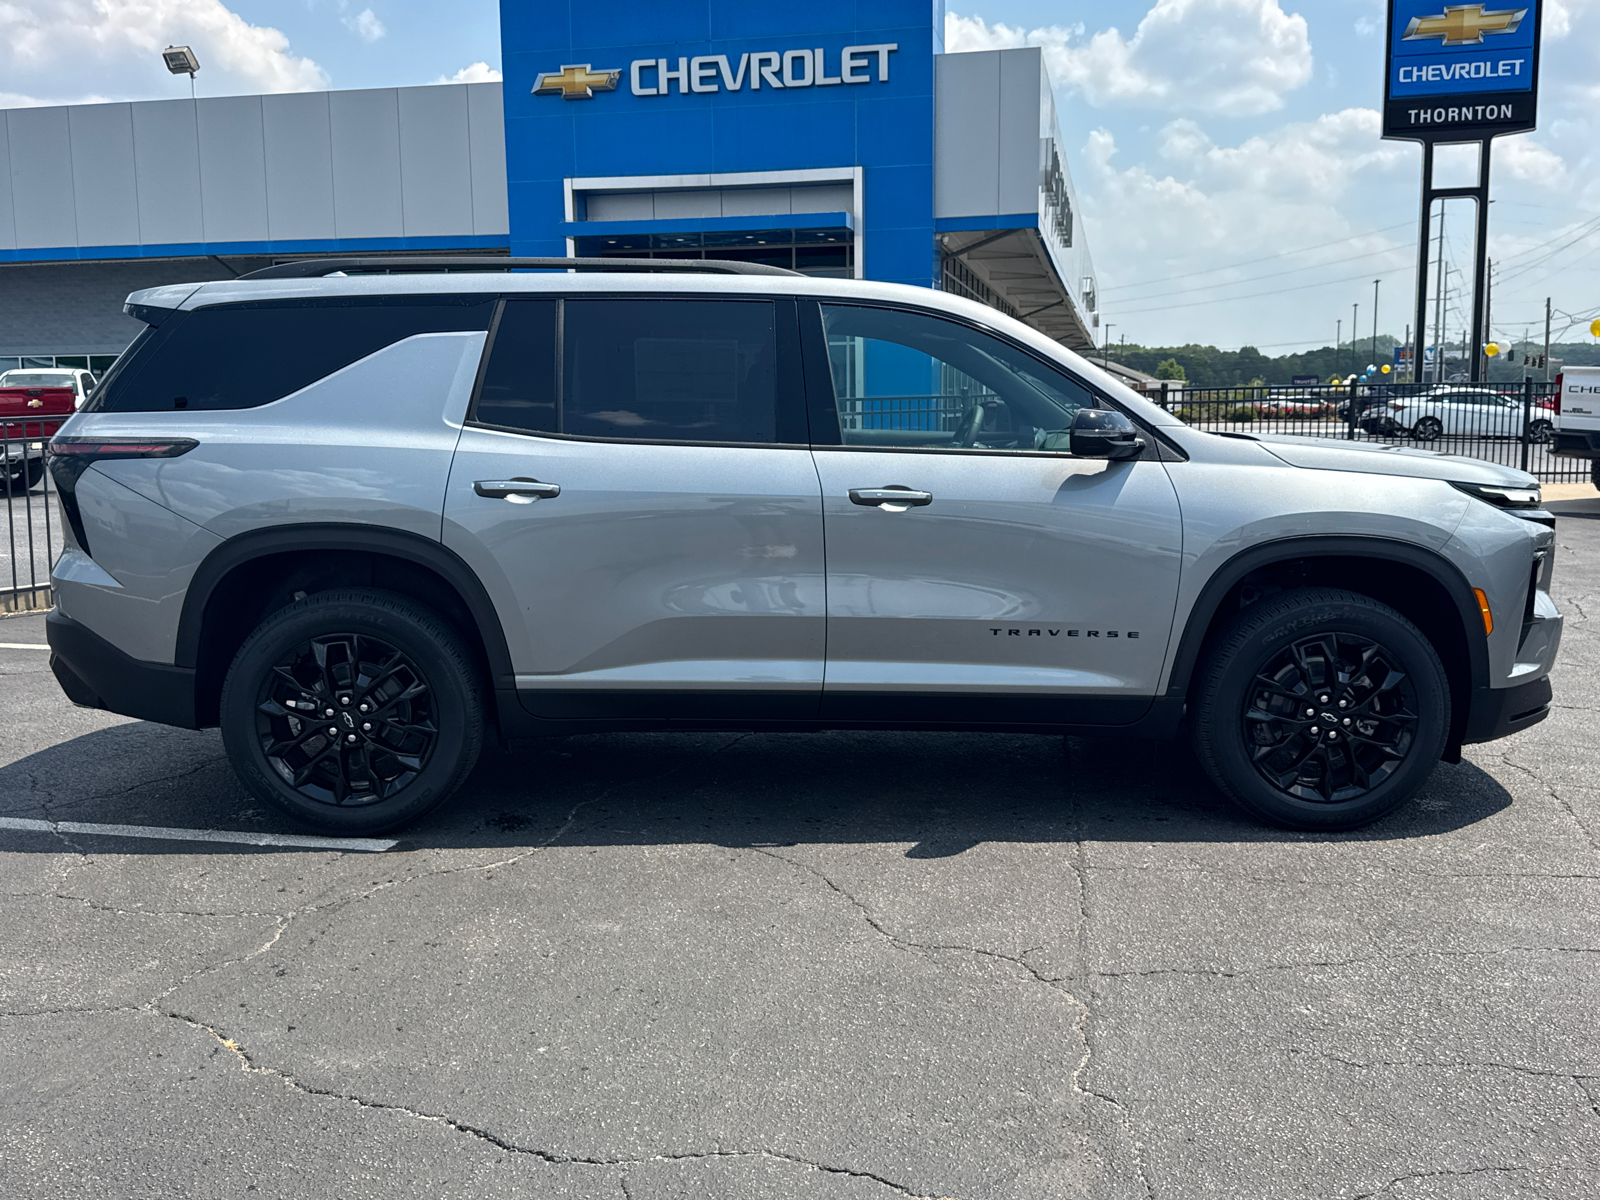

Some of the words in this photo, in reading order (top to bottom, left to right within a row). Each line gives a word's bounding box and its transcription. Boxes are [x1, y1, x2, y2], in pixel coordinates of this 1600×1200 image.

[630, 43, 898, 96] CHEVROLET
[1399, 59, 1525, 83] CHEVROLET
[1408, 104, 1512, 124] THORNTON
[989, 628, 1140, 639] TRAVERSE
